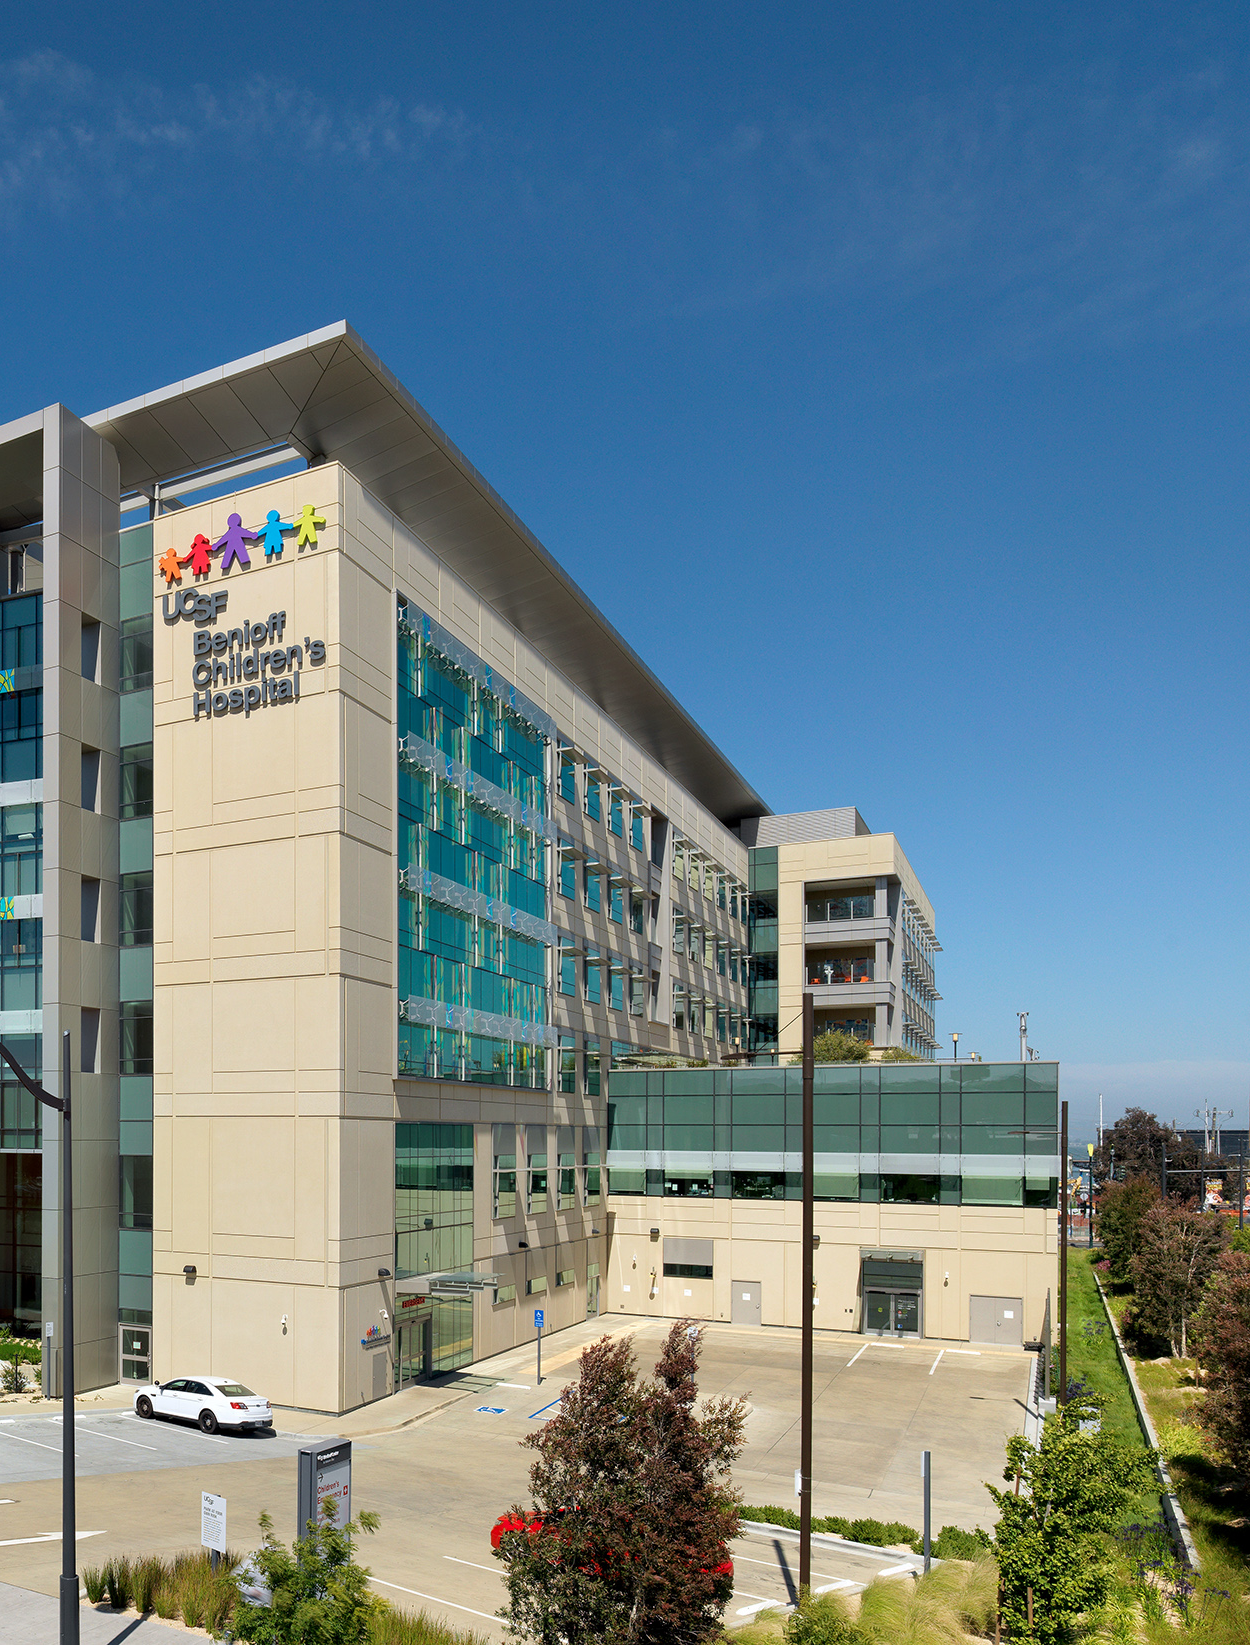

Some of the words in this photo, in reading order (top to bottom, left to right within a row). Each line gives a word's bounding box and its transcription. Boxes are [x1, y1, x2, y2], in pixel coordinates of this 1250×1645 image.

[162, 588, 228, 621] UCSF
[193, 611, 286, 656] Benioff
[192, 637, 326, 685] Children's
[193, 671, 299, 716] Hospital
[317, 1480, 340, 1495] Children's
